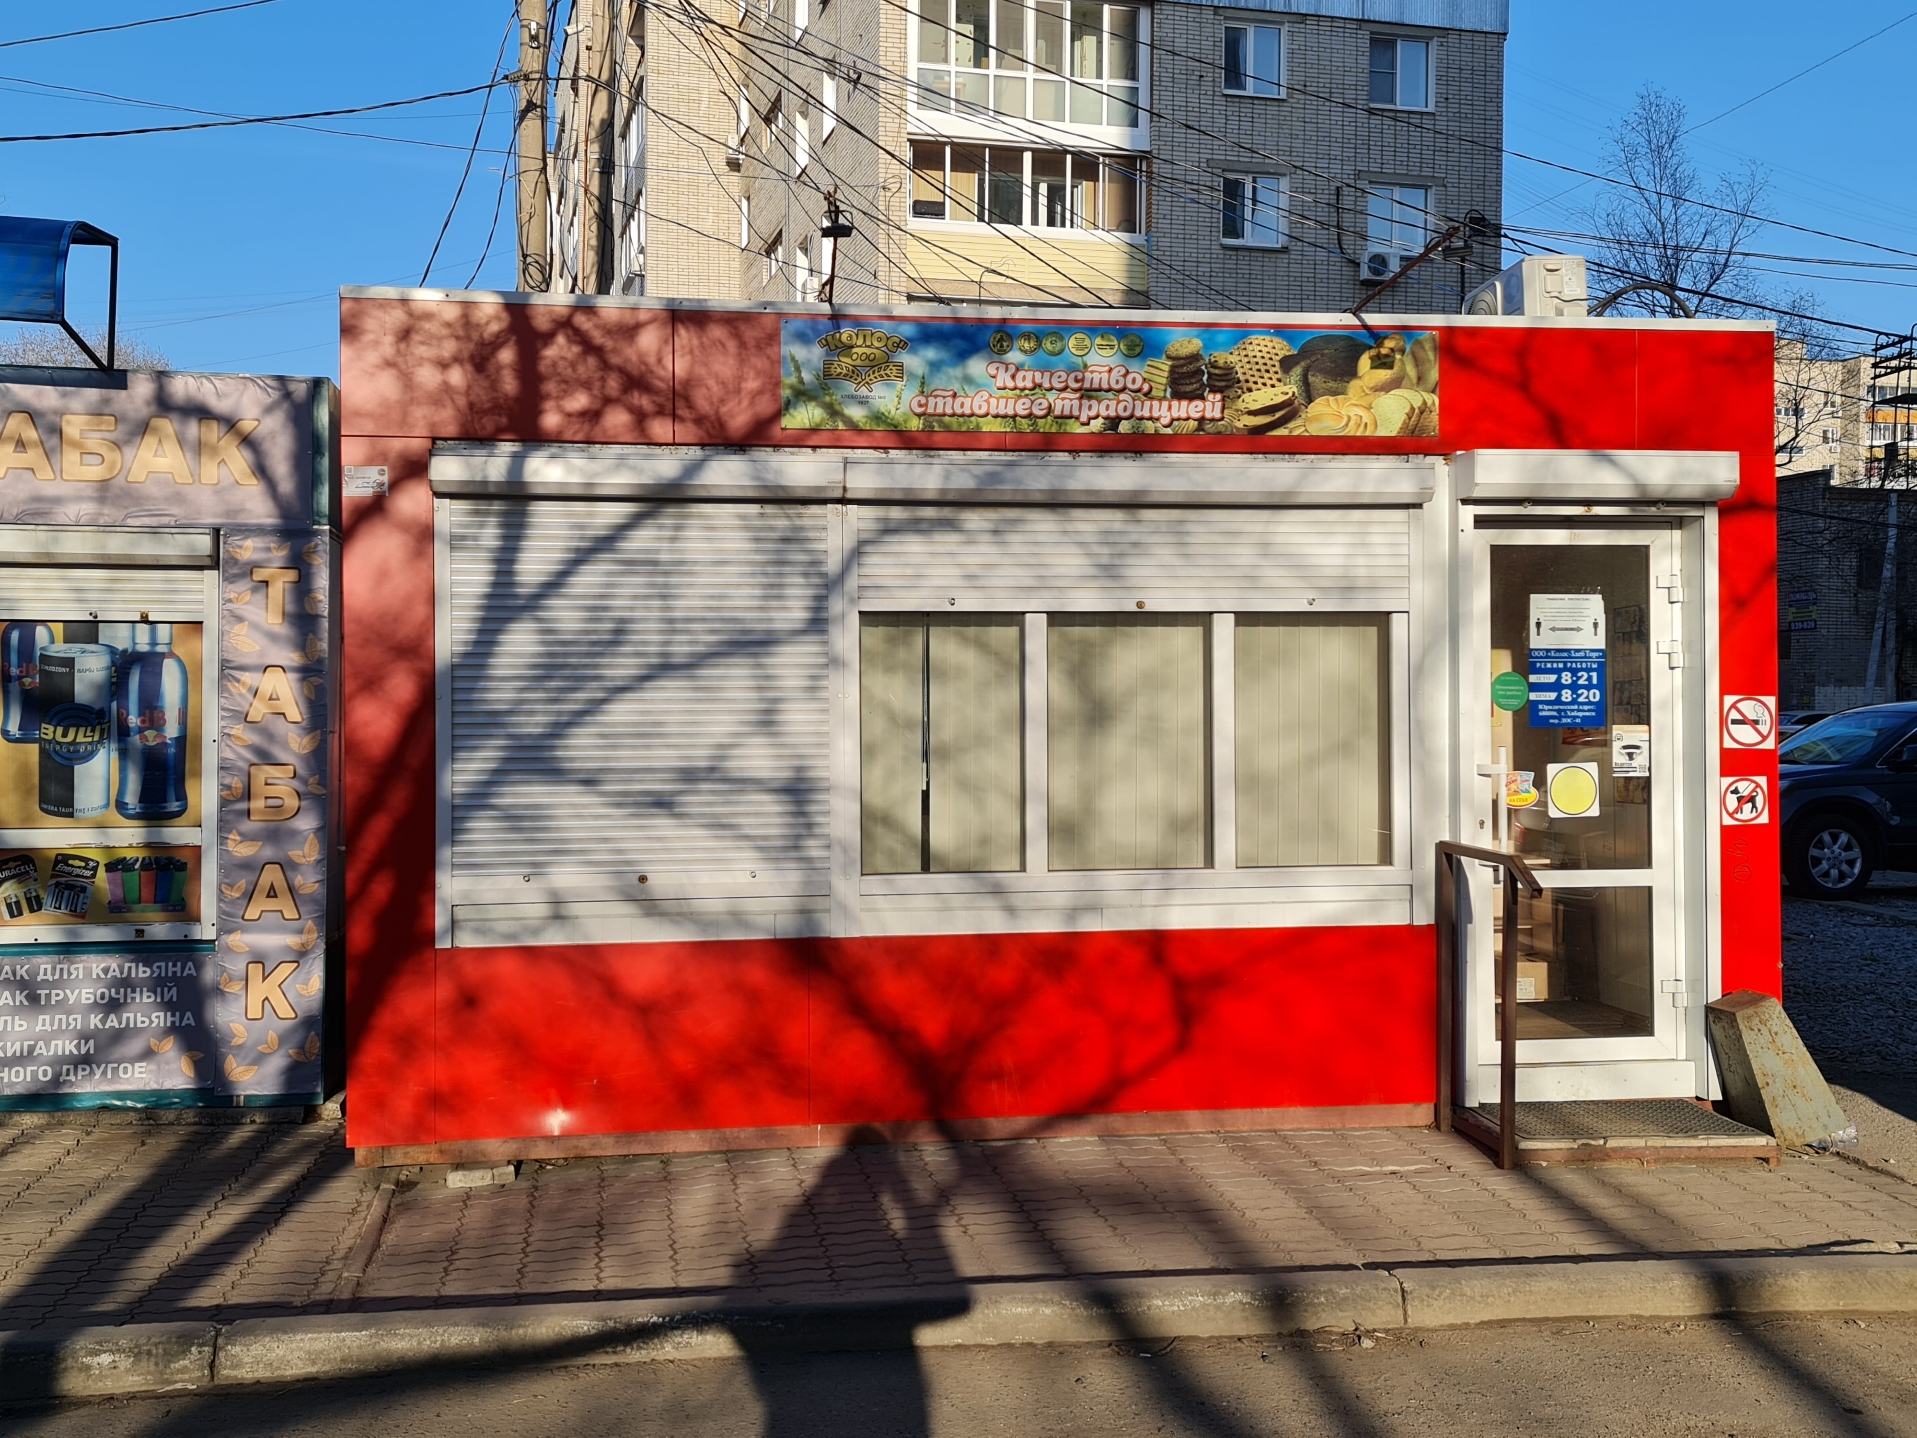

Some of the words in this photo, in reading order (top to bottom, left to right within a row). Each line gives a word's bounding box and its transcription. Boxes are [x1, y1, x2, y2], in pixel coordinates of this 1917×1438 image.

[987, 361, 1151, 394] Качество,
[910, 389, 1049, 418] ставшее
[1053, 391, 1225, 425] традицией
[119, 708, 150, 728] Red
[55, 862, 94, 878] Energizer
[37, 964, 83, 982] ДЛЯ
[91, 961, 197, 979] КАЛЬЯНА
[36, 982, 177, 1005] ТРУБОЧНЫЙ
[35, 1014, 81, 1033] ДЛЯ
[90, 1011, 196, 1029] КАЛЬЯНА
[59, 1062, 147, 1082] ДРУГОЕ
